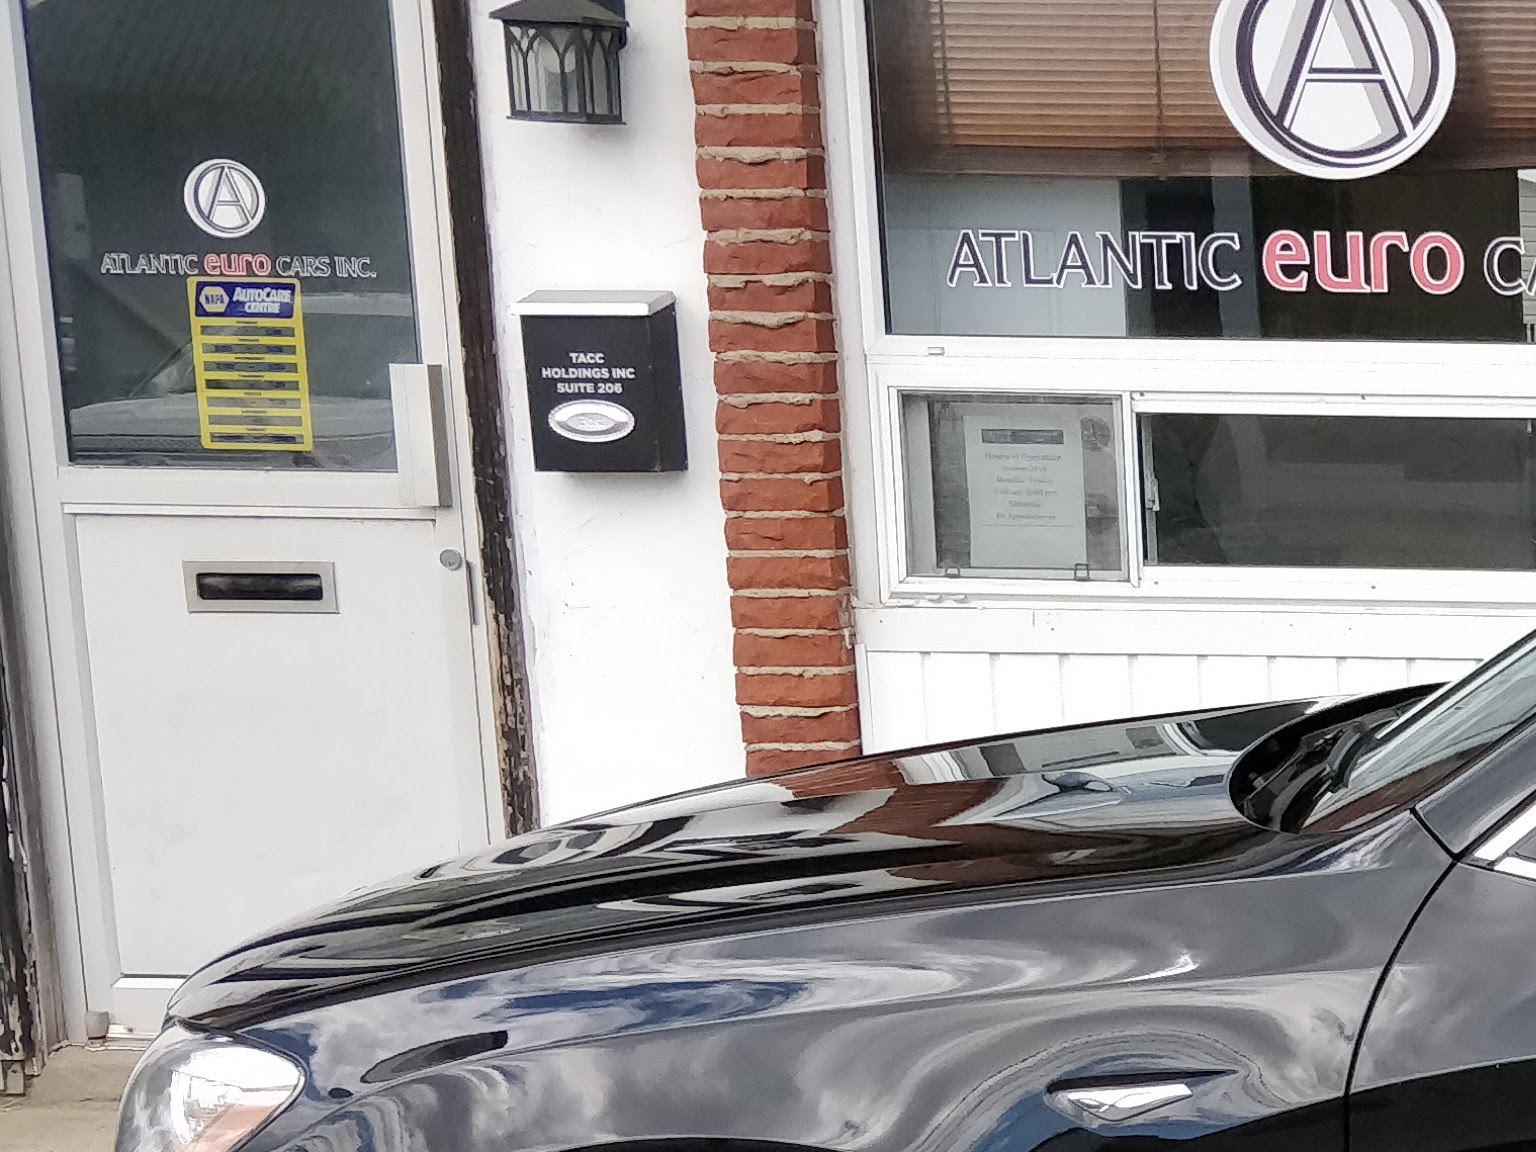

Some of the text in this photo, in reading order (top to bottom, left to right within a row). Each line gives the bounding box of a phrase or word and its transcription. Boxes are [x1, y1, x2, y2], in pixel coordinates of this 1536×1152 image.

[101, 252, 378, 278] ATLANTIC euro CARS INC.
[946, 229, 1242, 291] ATLANTIC
[1262, 229, 1466, 295] euro
[569, 352, 605, 364] TACC
[541, 367, 636, 379] HOLDINGS INC
[556, 382, 623, 394] SUITE 206
